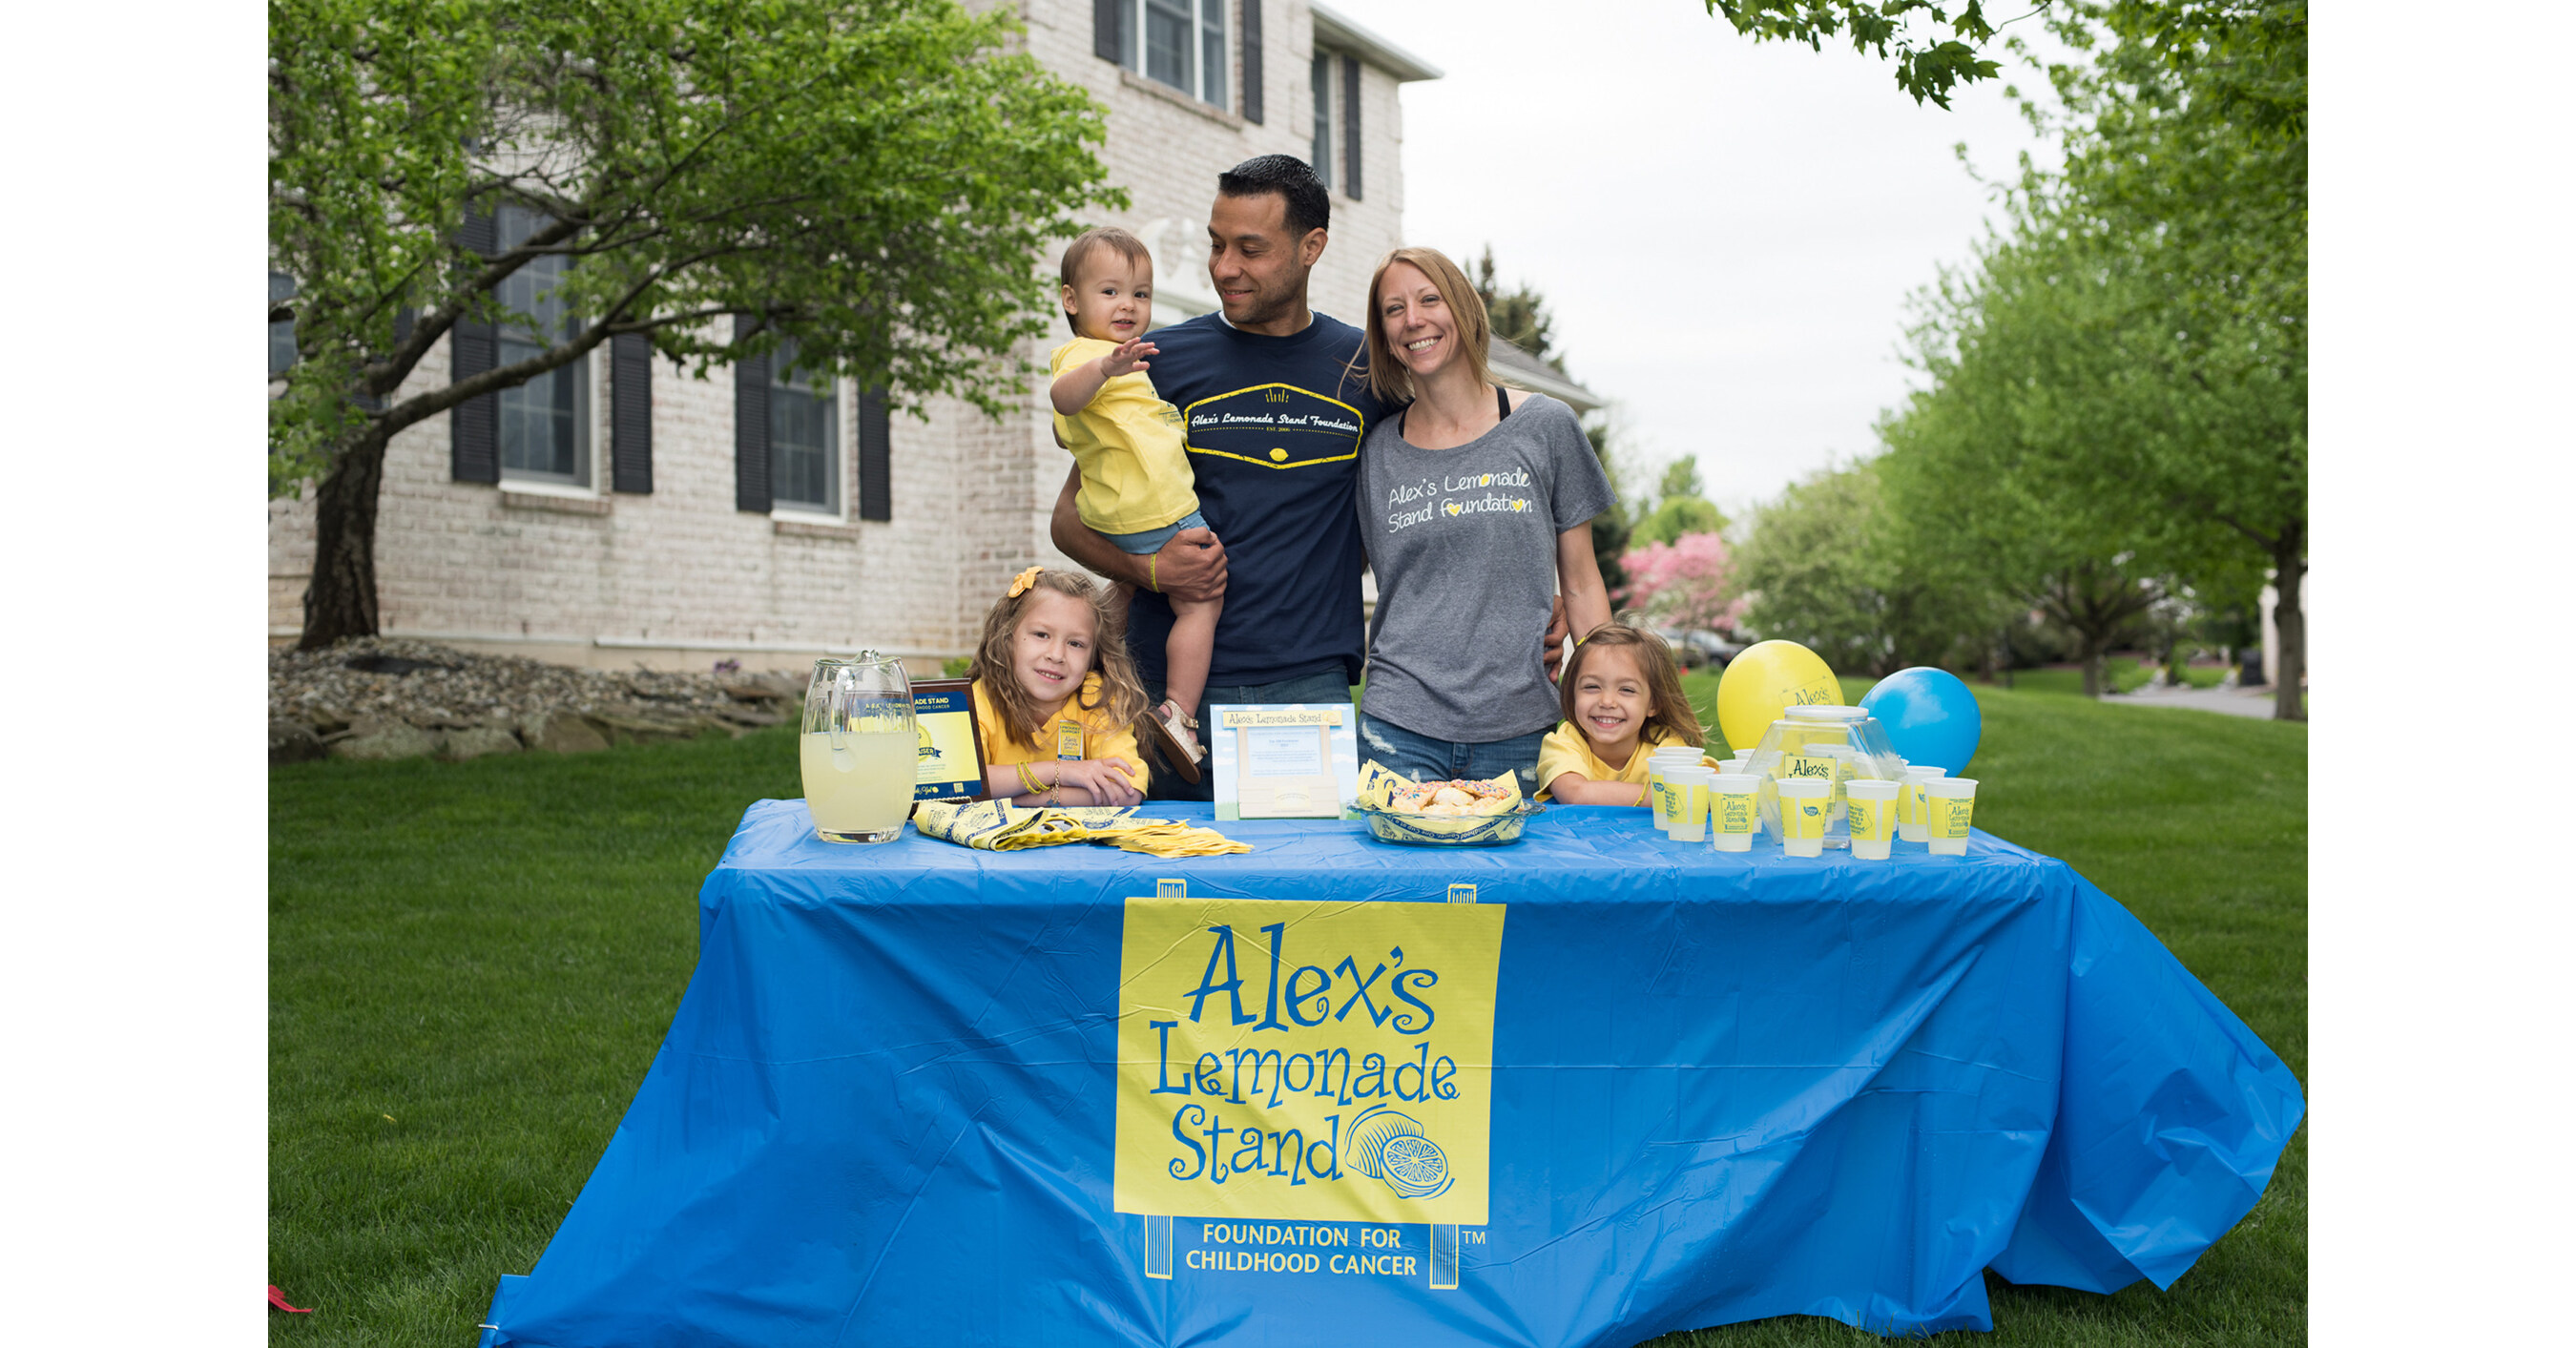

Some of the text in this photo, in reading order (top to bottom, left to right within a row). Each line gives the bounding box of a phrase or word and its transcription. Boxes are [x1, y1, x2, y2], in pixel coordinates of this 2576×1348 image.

[1191, 412, 1219, 428] Alex's
[1221, 412, 1275, 425] Lemonade
[1278, 414, 1307, 425] Stand
[1310, 415, 1359, 433] Foundation
[1388, 467, 1531, 510] Alex's Lemonade
[1388, 501, 1434, 534] Stand
[927, 696, 949, 705] STAND
[1795, 686, 1831, 706] Alex's
[1229, 713, 1321, 725] Alex's Lemonade Stand
[1794, 759, 1829, 778] Alex's
[1183, 922, 1439, 1036] Alex's
[1149, 1020, 1461, 1110] Lemonade
[1168, 1103, 1344, 1187] Stand
[1202, 1223, 1402, 1250] FOUNDATION FOR
[1462, 1230, 1486, 1245] TM
[1185, 1249, 1417, 1276] CHILDHOOD CANCER
